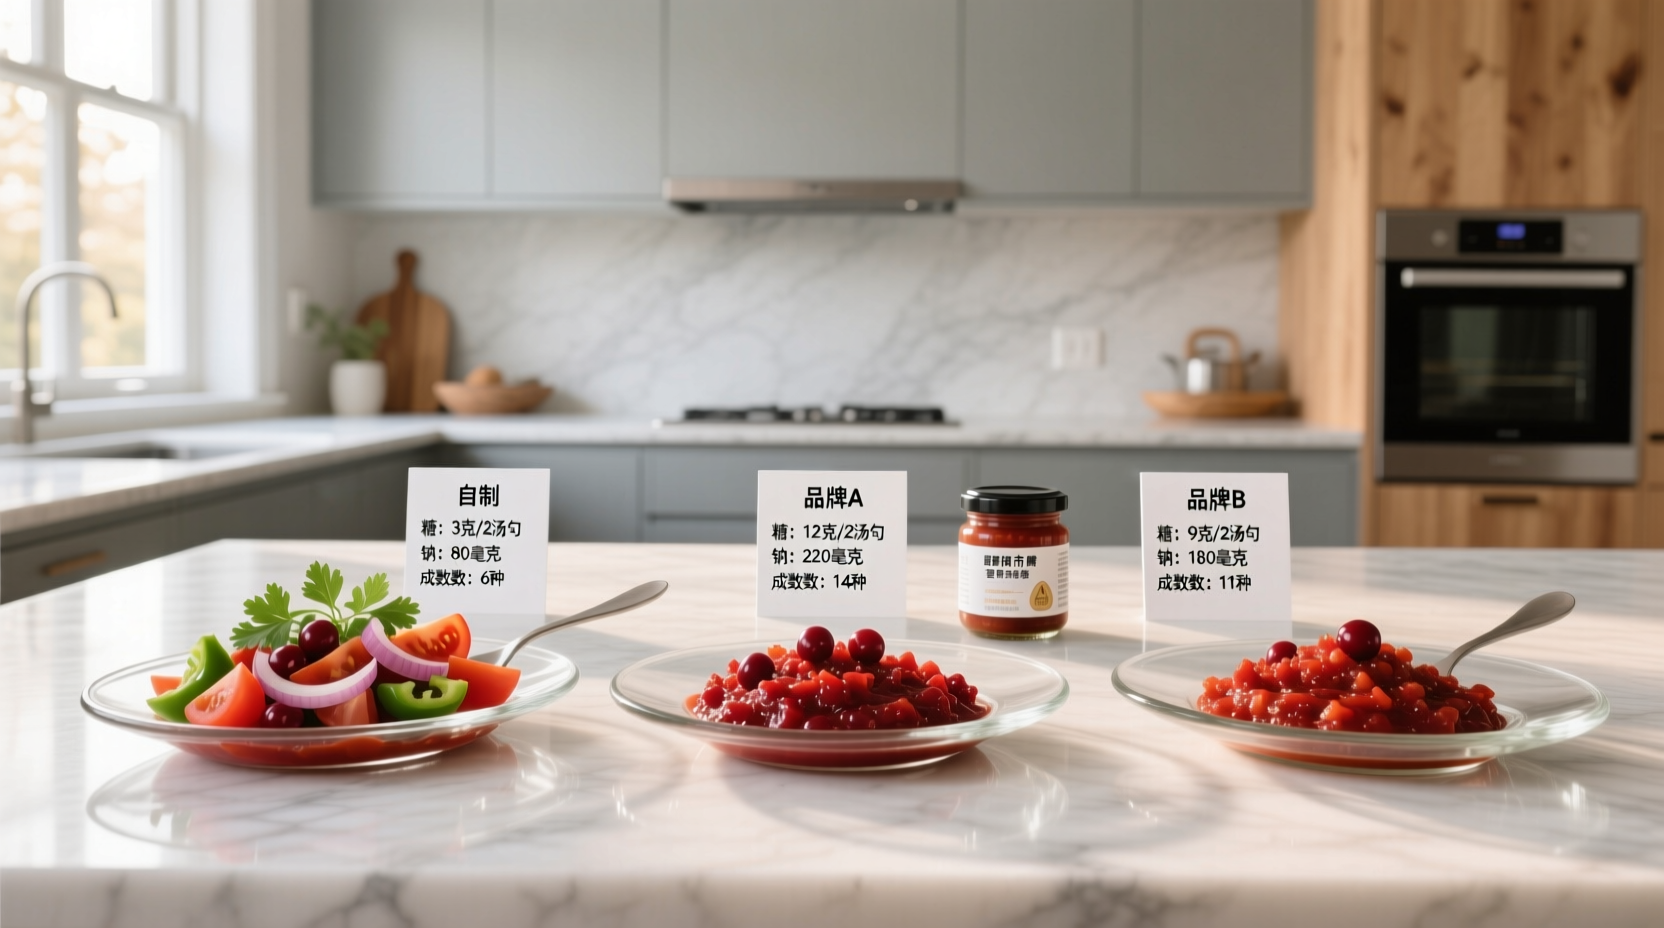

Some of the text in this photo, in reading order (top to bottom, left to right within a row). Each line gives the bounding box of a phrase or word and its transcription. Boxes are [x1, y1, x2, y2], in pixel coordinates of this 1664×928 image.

[459, 483, 500, 507] 自制
[804, 485, 864, 510] 品牌A
[1187, 486, 1246, 512] 品牌B
